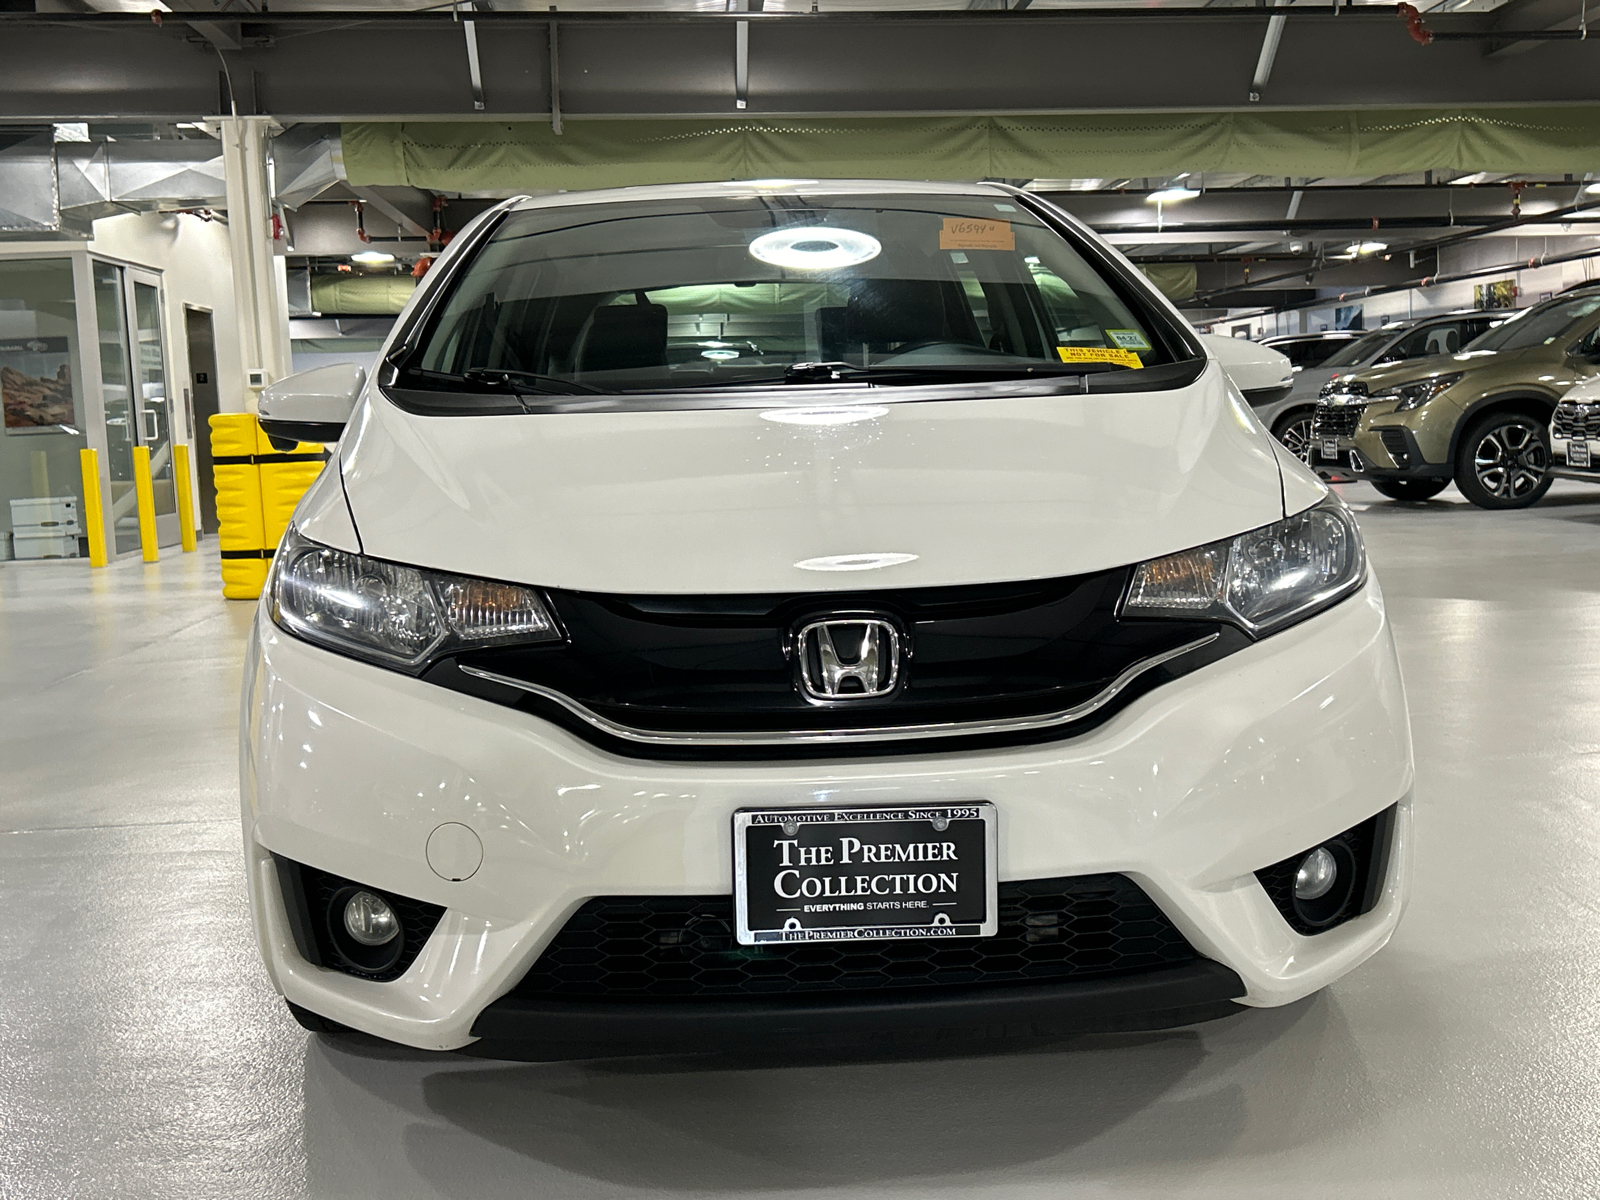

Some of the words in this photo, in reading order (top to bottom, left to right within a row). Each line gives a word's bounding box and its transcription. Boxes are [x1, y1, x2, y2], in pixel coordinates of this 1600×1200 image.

[947, 808, 978, 818] 1995
[803, 902, 865, 913] EVERYTHING
[866, 901, 901, 910] STARTS
[902, 900, 930, 909] HERE.
